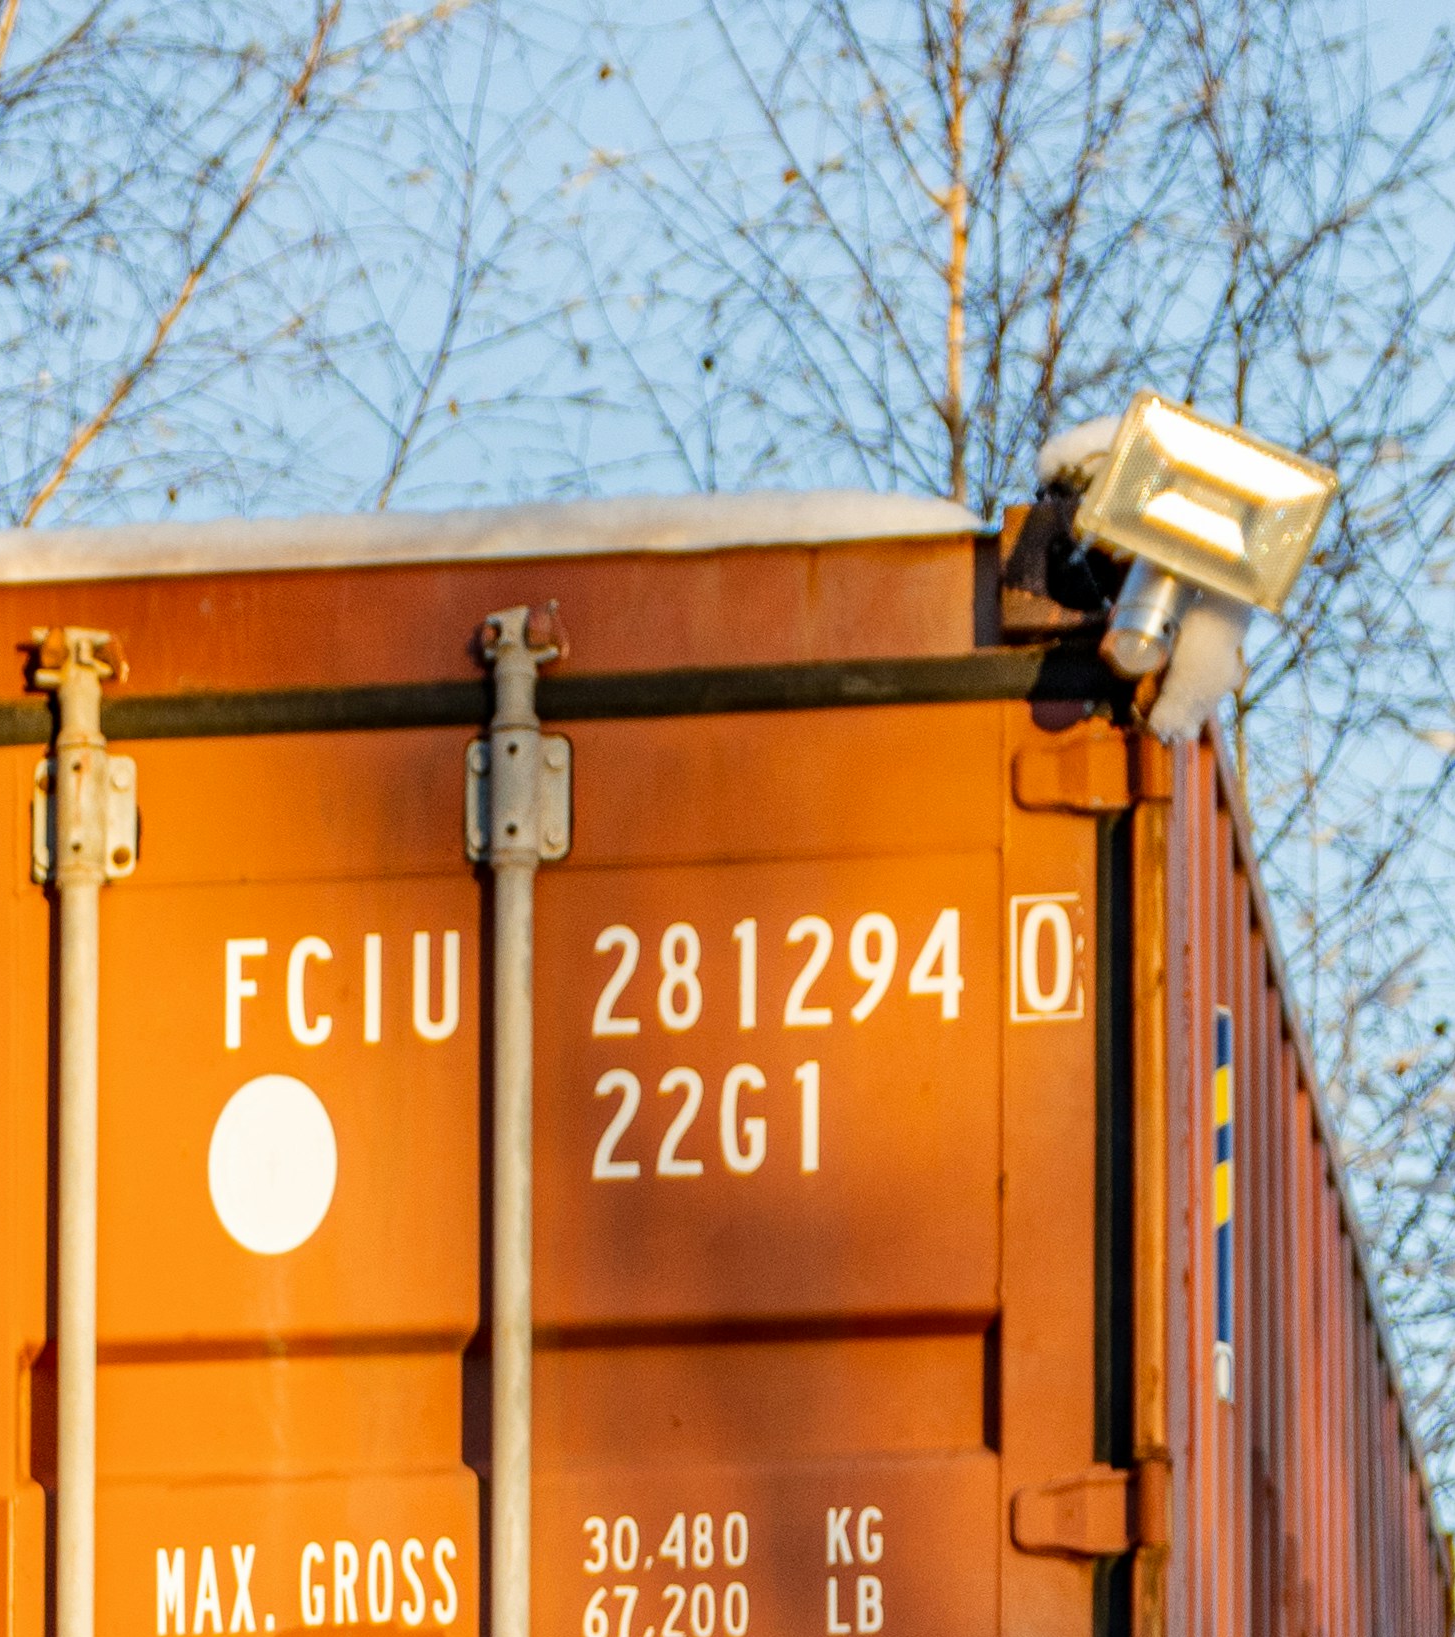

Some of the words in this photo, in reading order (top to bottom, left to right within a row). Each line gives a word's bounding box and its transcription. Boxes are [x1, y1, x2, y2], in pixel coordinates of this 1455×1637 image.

[225, 932, 460, 1049] FCIU
[592, 908, 965, 1036] 281294
[1020, 900, 1073, 1013] 0
[592, 1060, 820, 1179] 22G1
[826, 1506, 884, 1566] KG
[155, 1543, 276, 1636] MAX.
[300, 1537, 458, 1626] GROSS
[826, 1575, 885, 1635] LB
